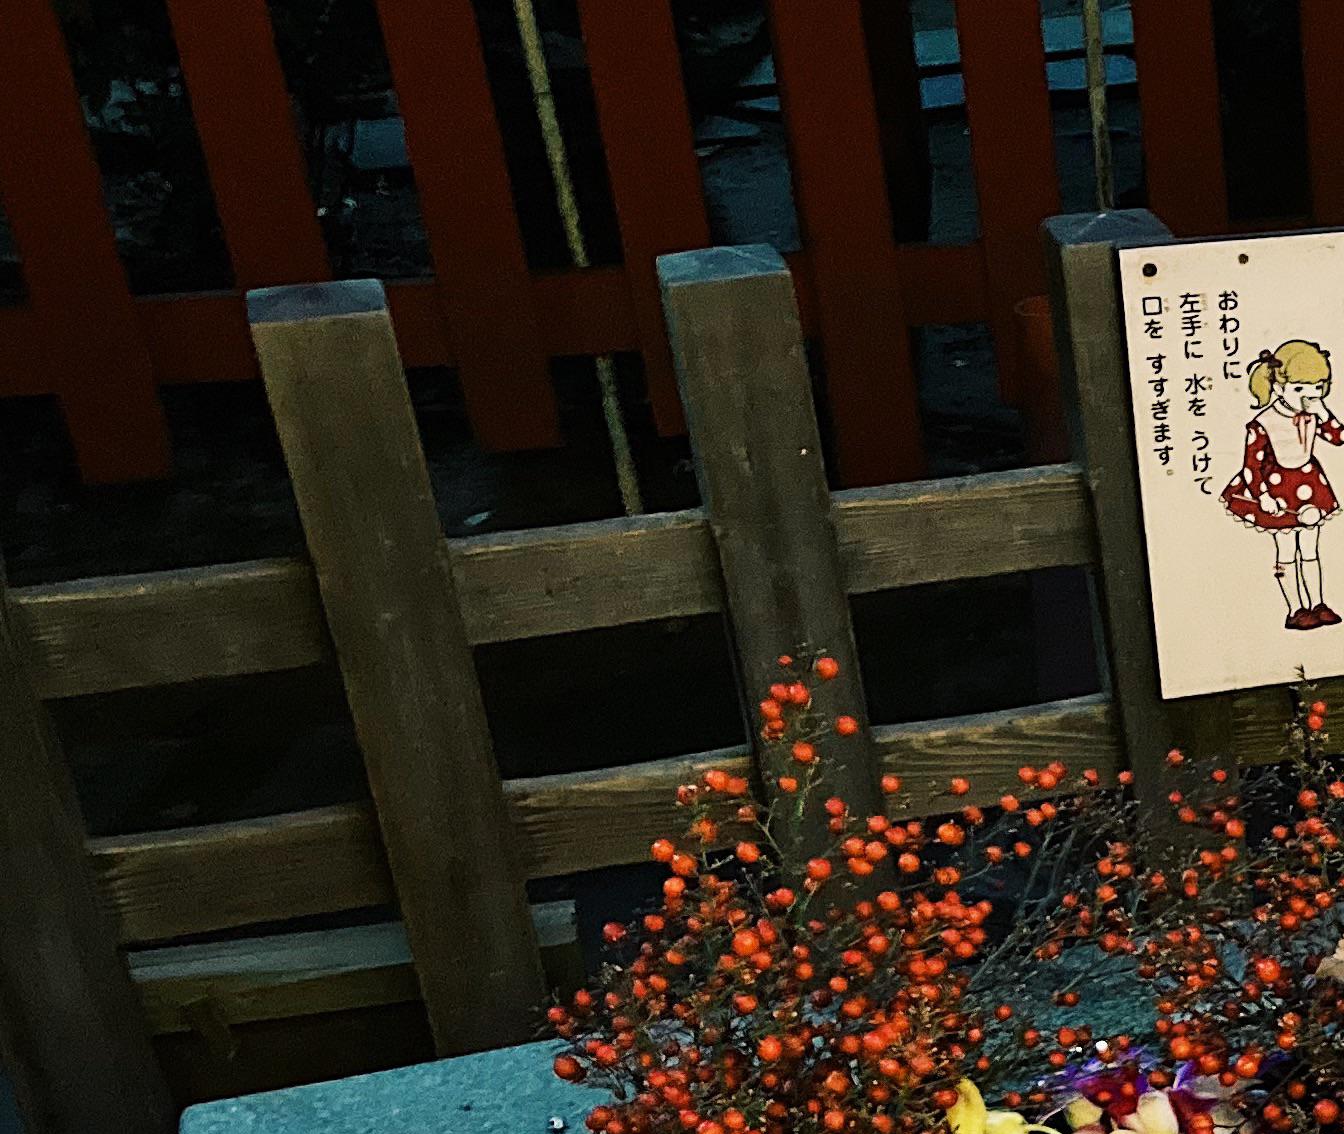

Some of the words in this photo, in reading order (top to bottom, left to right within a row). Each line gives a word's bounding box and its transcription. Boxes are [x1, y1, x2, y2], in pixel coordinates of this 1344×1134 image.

[1142, 296, 1164, 339] 口を
[1179, 293, 1204, 359] 左手に
[1218, 290, 1242, 380] おわりに
[1146, 353, 1174, 476] すすぎます。
[1185, 373, 1206, 417] 水を
[1191, 430, 1213, 495] うけて
